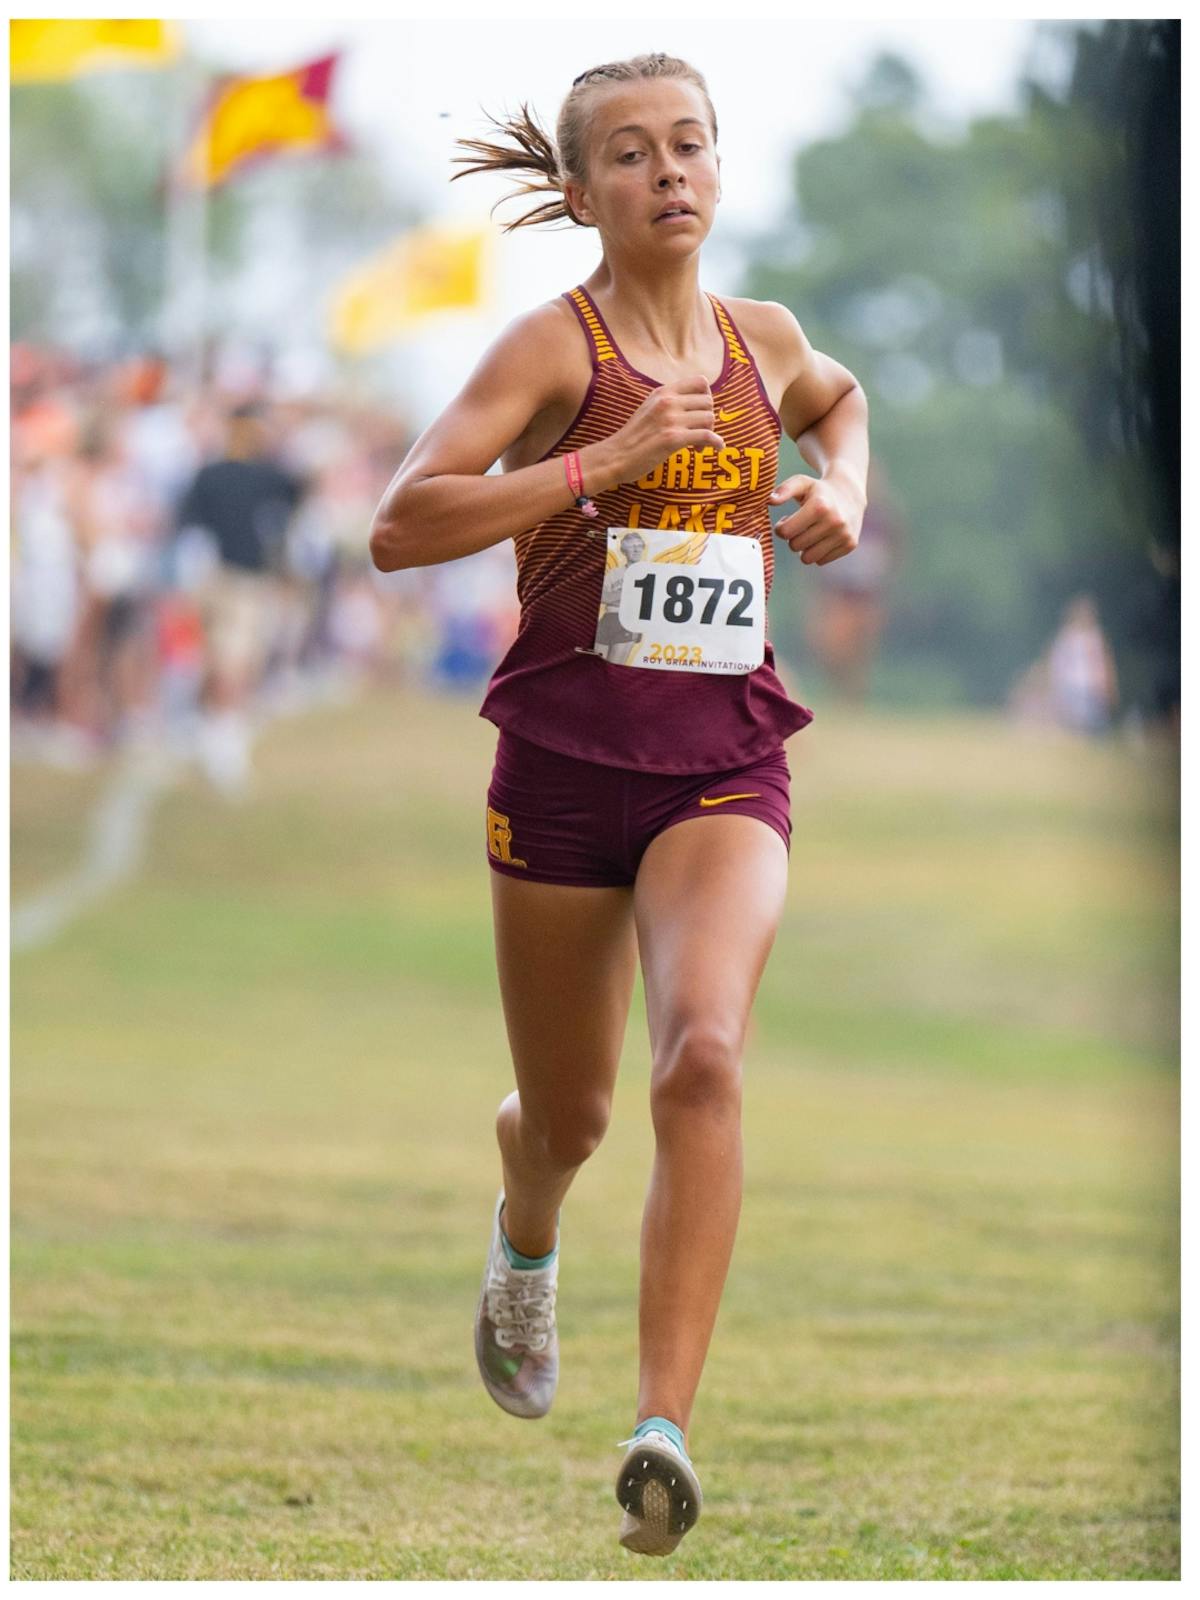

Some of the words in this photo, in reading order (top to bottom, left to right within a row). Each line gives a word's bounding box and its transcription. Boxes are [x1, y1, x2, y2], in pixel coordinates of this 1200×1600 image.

[608, 446, 765, 491] OREST
[634, 573, 754, 627] 1872
[642, 656, 663, 665] ROY
[697, 660, 759, 672] INVITATIONA
[650, 642, 703, 665] 2023
